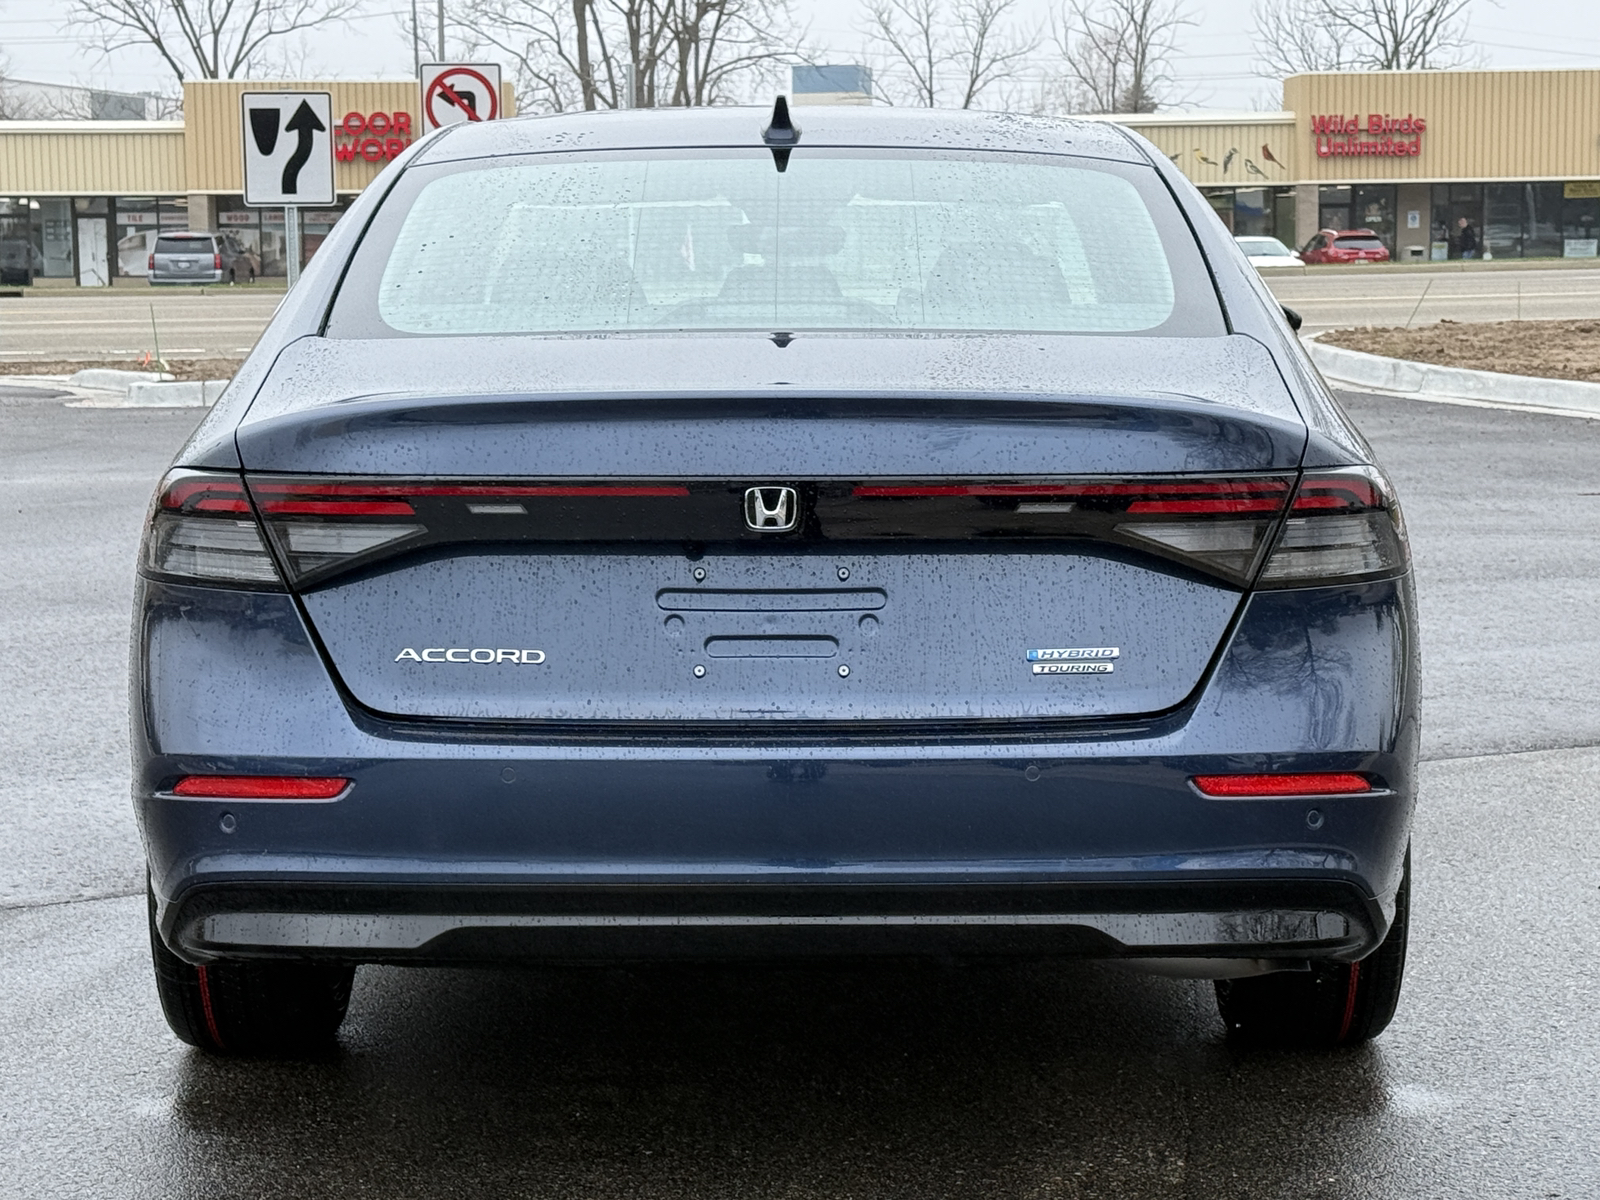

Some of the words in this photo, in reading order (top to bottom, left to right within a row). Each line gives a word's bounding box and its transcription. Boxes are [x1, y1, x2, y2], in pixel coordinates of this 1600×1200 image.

[1311, 114, 1359, 134] Wild
[1367, 113, 1426, 134] Birds
[1316, 135, 1421, 157] Unlimited
[395, 648, 546, 664] ACCORD
[1041, 649, 1114, 659] HYBRID
[1038, 664, 1108, 673] TOURING
